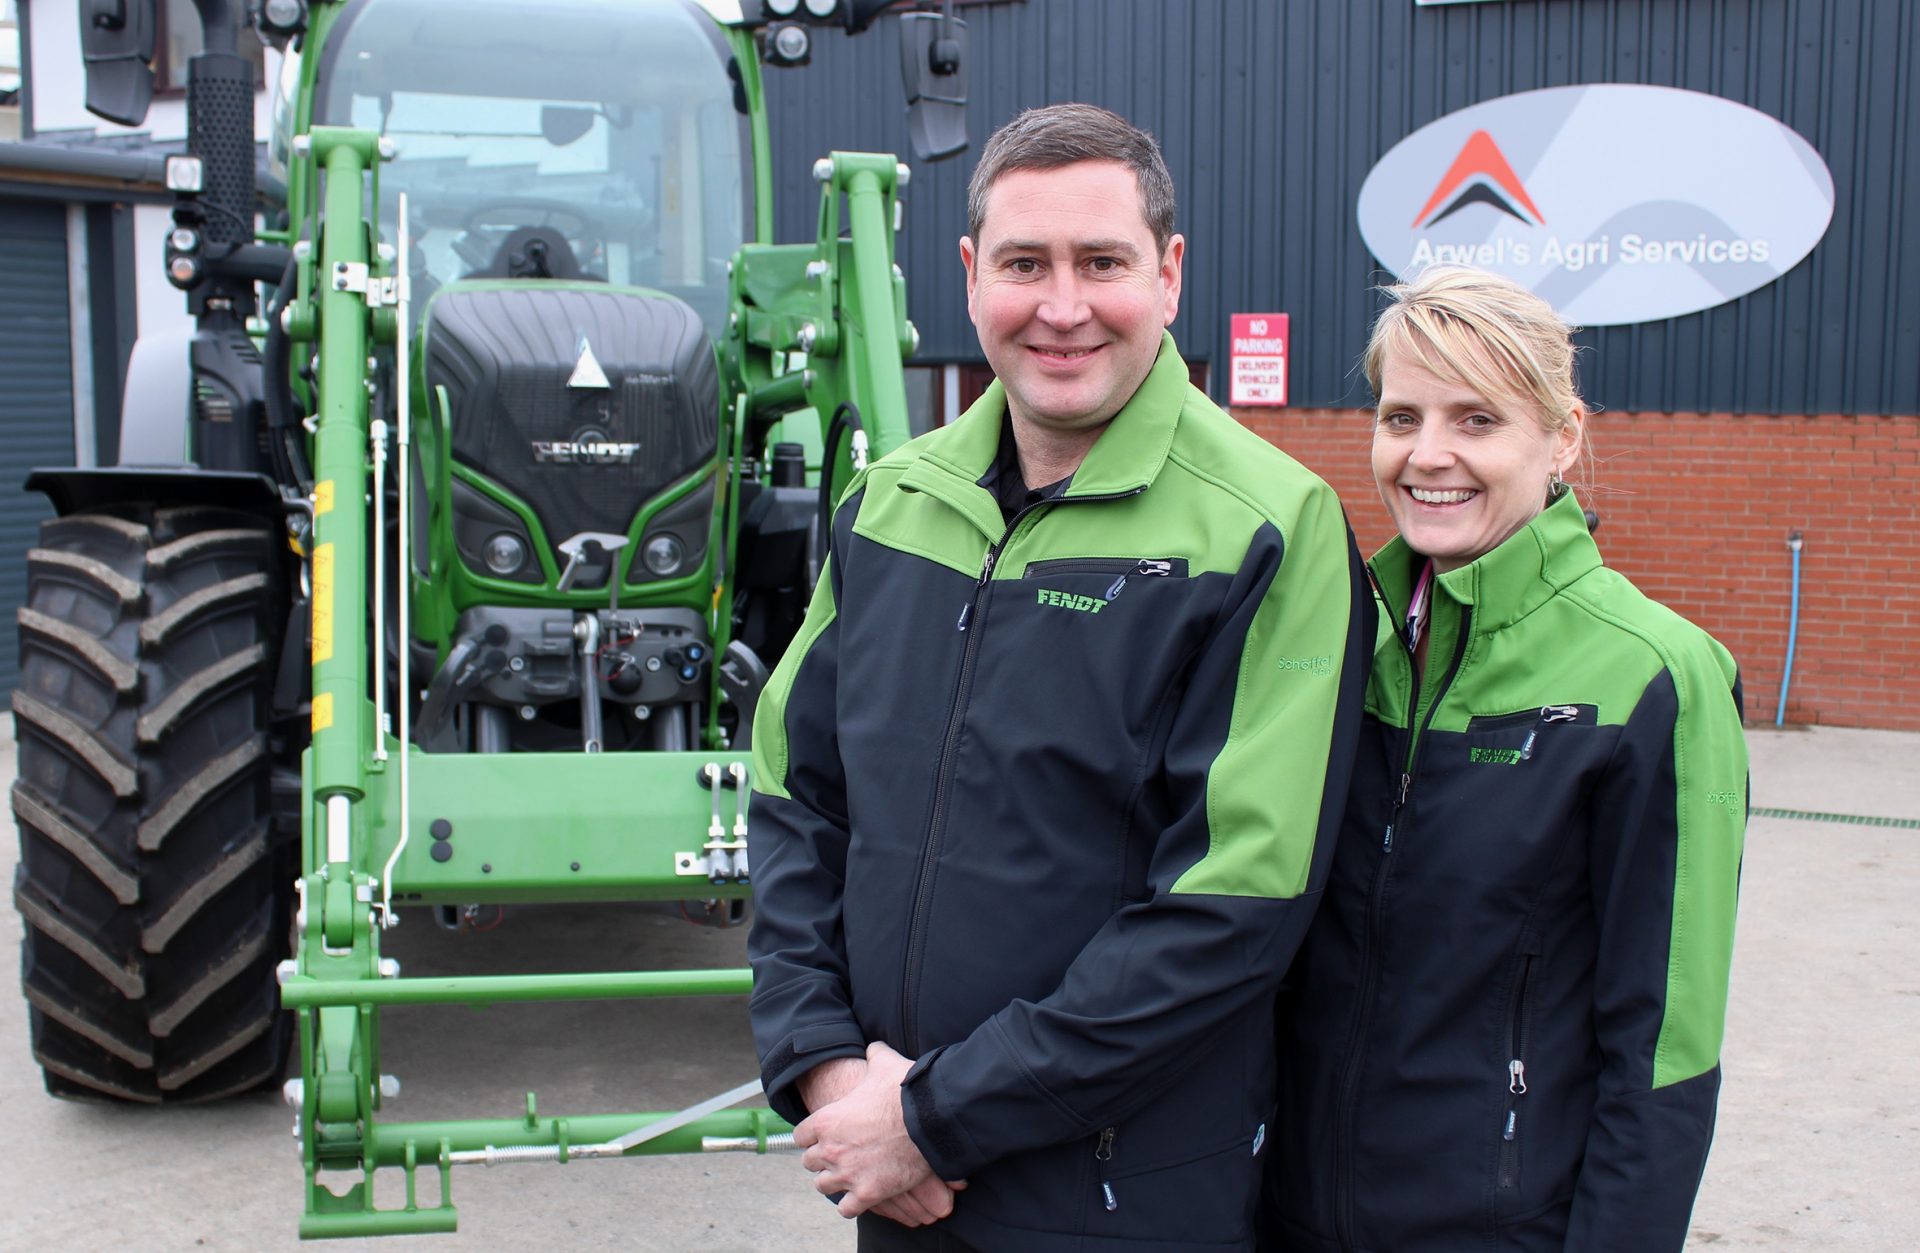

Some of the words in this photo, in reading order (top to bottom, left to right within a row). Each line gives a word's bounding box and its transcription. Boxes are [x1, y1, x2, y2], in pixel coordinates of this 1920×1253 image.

[1410, 237, 1530, 267] Arwel's
[1540, 236, 1609, 271] Agri
[1619, 234, 1770, 263] Services
[1249, 320, 1268, 336] NO
[1234, 338, 1283, 354] PARKING
[1237, 361, 1279, 371] DELIVERY
[1238, 375, 1280, 384] VEHICLES
[1247, 388, 1269, 397] ONLY
[531, 440, 642, 464] FENDT
[1036, 588, 1108, 614] FENDT
